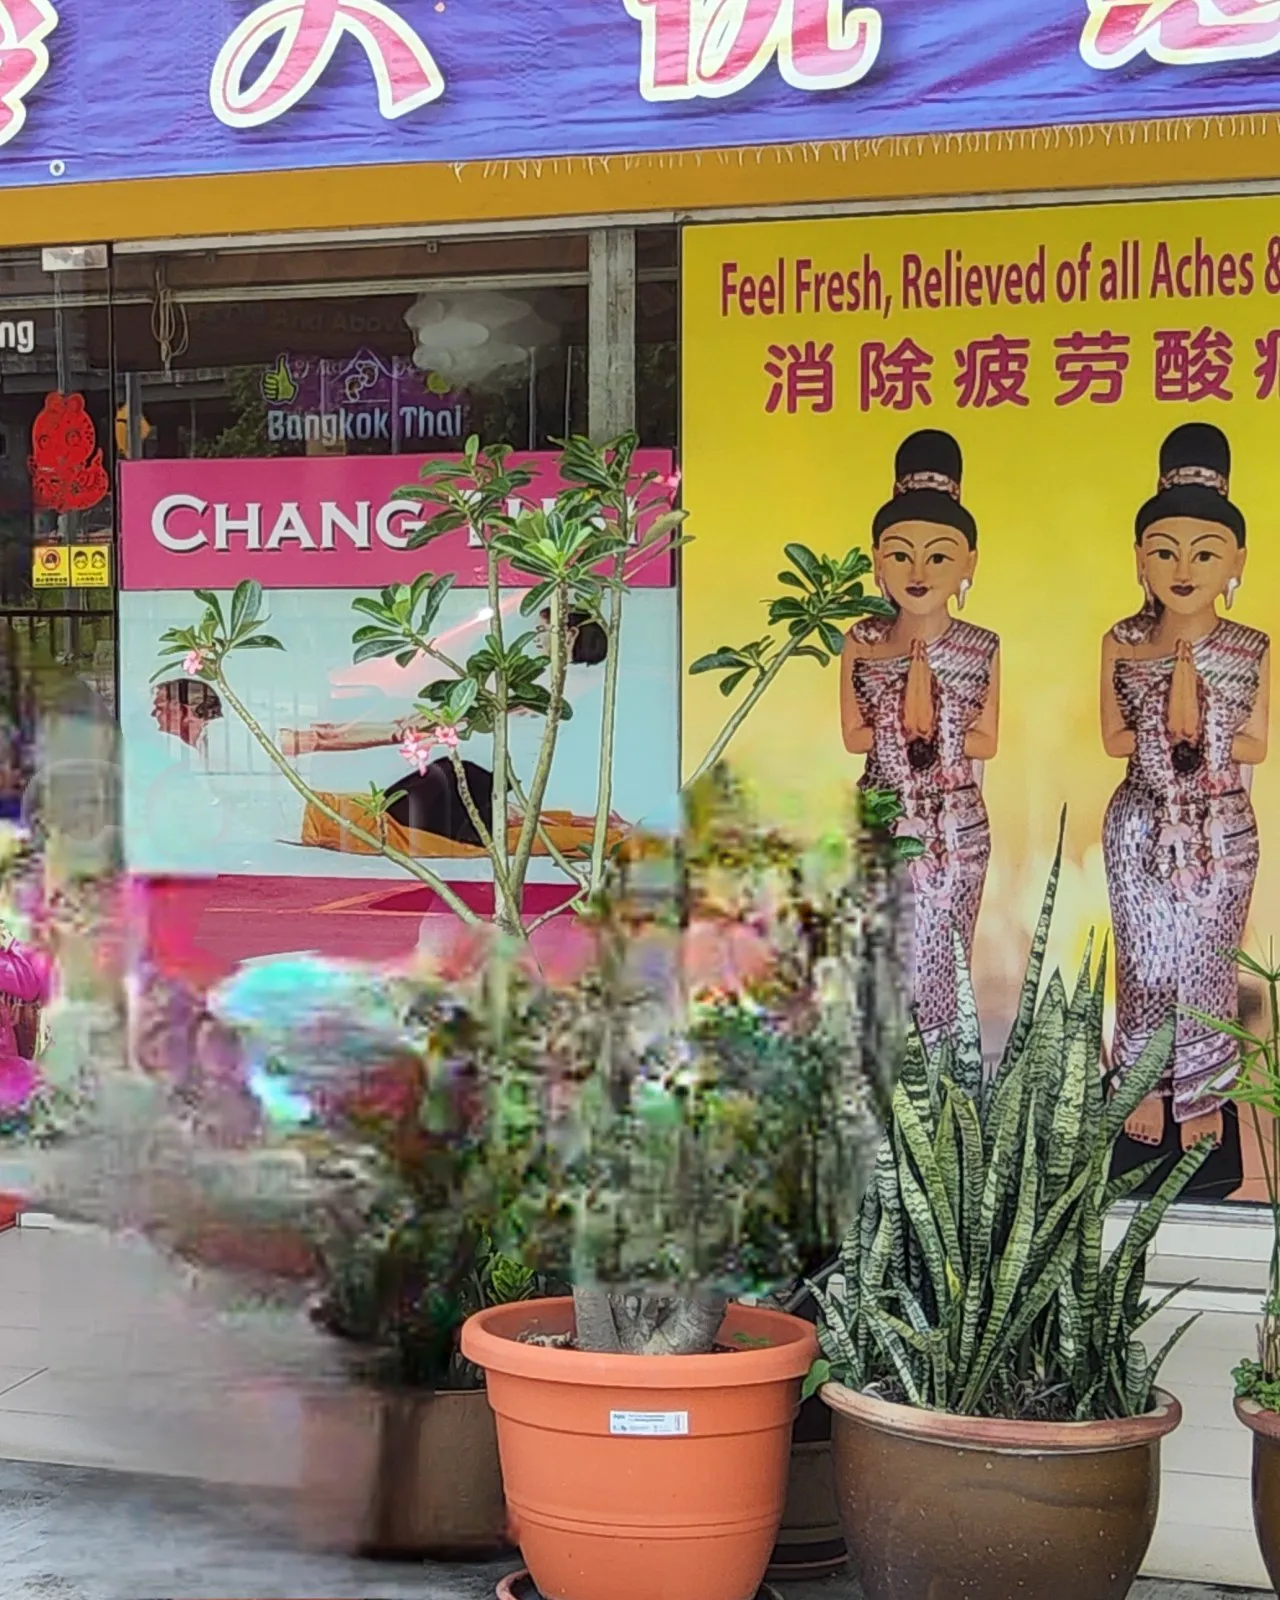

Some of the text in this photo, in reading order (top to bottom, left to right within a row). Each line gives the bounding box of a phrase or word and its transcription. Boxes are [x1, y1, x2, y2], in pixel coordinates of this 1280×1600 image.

[721, 257, 786, 317] Feel
[794, 253, 892, 319] Fresh,
[901, 244, 1045, 309] Relieved
[1056, 241, 1092, 302] of
[1100, 240, 1140, 301] all
[1149, 236, 1254, 299] Aches
[268, 402, 462, 446] Bangkok Thai
[151, 494, 426, 553] CHANG
